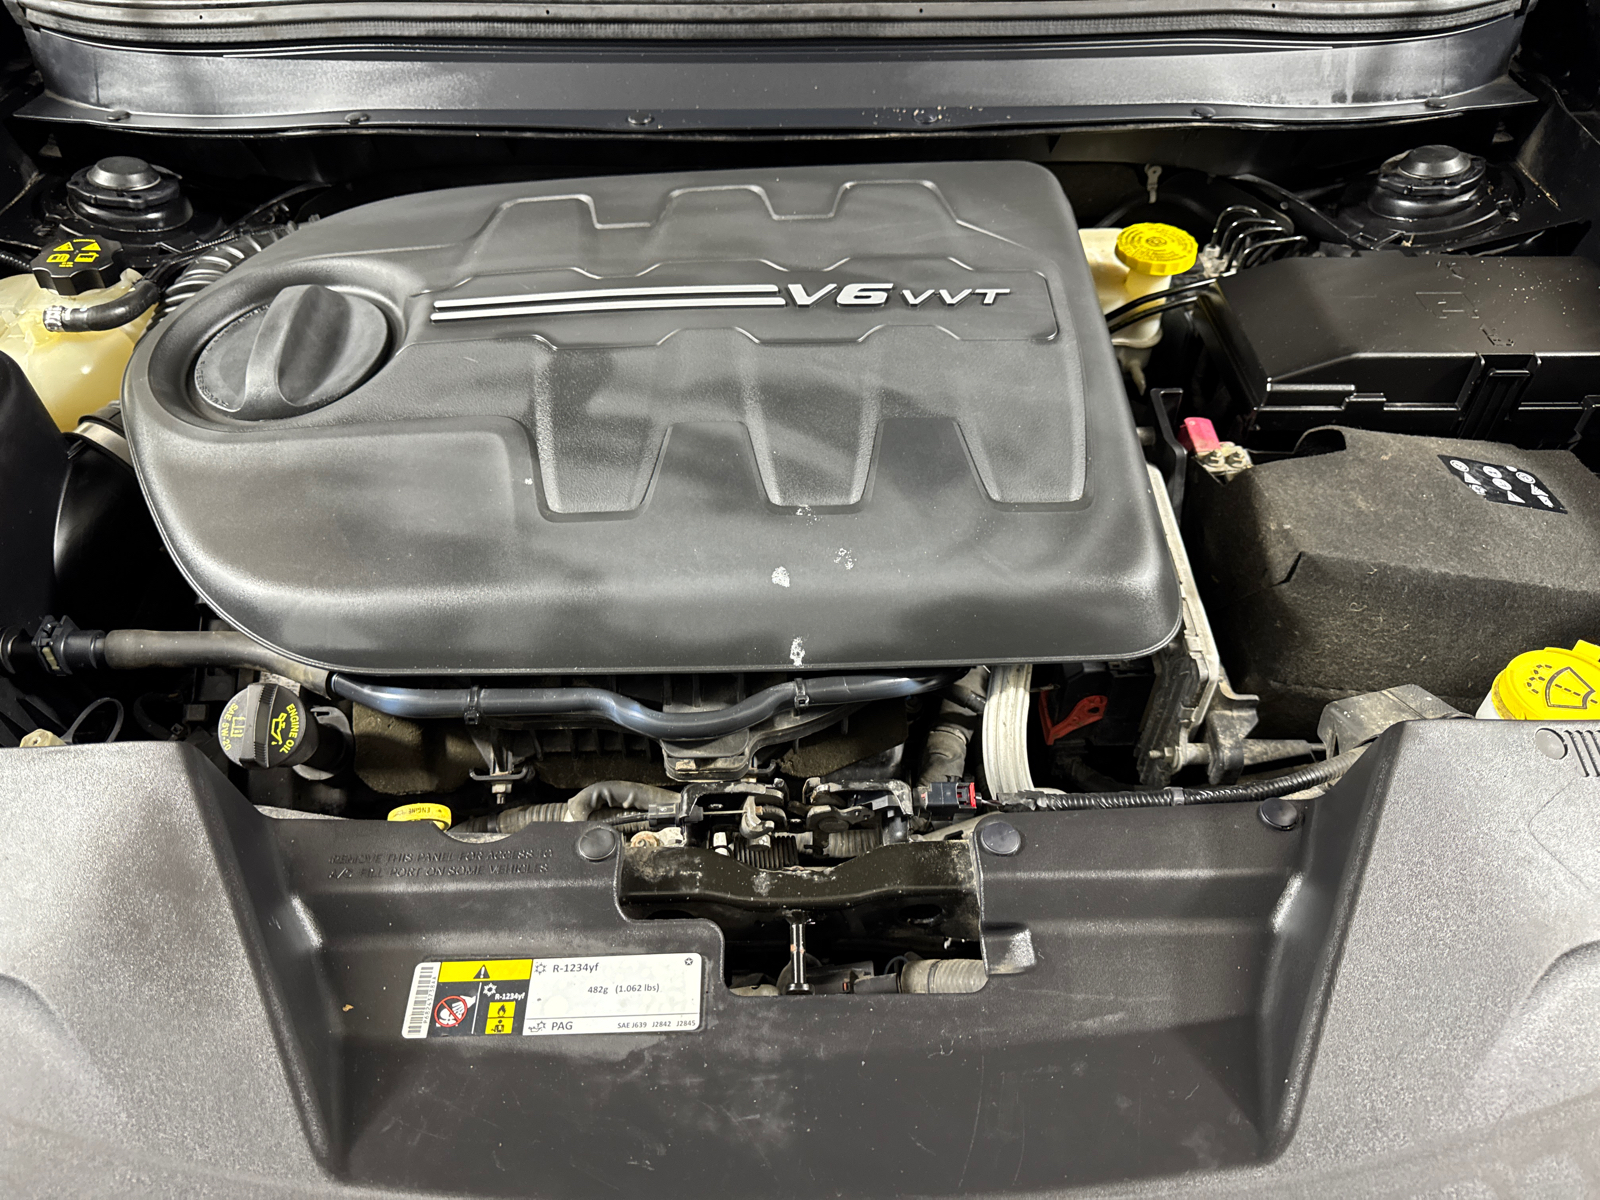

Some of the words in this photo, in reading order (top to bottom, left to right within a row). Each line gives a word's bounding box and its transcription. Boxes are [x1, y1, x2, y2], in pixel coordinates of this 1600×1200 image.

[787, 283, 893, 307] V6
[901, 289, 1010, 307] VVT
[223, 703, 239, 721] SAE
[285, 703, 300, 738] ENGINE
[279, 739, 295, 754] OIL
[329, 853, 383, 865] REMOVE
[386, 853, 413, 863] THIS
[417, 852, 454, 862] PANEL
[458, 851, 484, 861] FOR
[487, 849, 534, 860] ACCESS
[328, 867, 353, 879] A/C
[360, 868, 383, 878] FILL
[390, 867, 423, 877] PORT
[425, 866, 446, 877] ON
[448, 865, 484, 876] SOME
[489, 863, 549, 875] VEHICLES
[552, 961, 599, 973] R-1234yf
[494, 992, 526, 1001] R-1234yf
[587, 985, 609, 995] 482g
[615, 984, 642, 994] (1.062
[644, 983, 660, 993] lbs)
[551, 1021, 574, 1031] PAG
